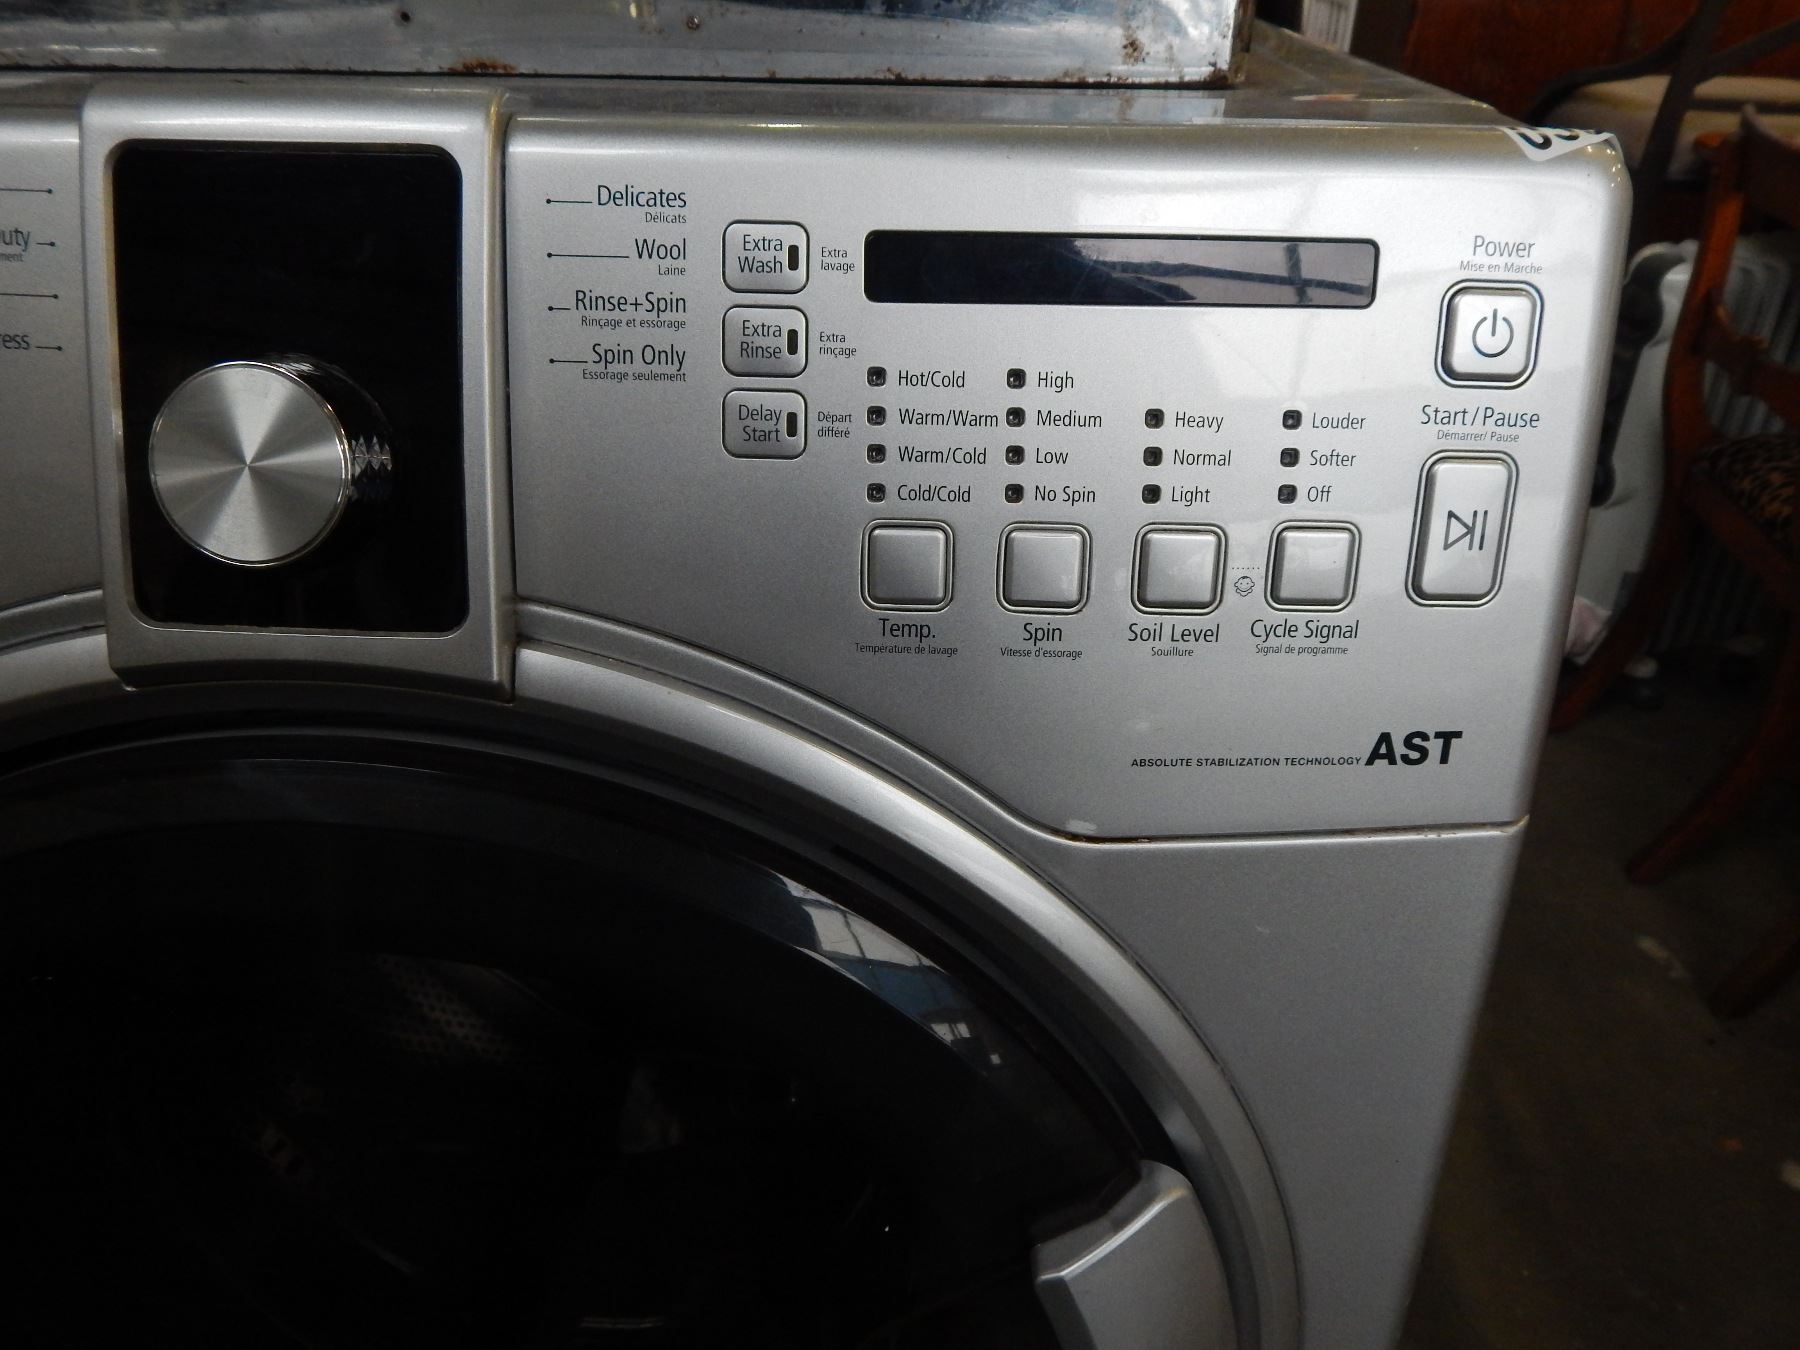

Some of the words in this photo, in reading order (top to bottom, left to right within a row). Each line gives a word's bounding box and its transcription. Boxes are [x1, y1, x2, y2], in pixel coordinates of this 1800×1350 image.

[597, 185, 687, 208] Delicates
[645, 212, 687, 224] Délicats
[0, 227, 31, 252] uty
[743, 234, 783, 251] Extra
[1473, 235, 1535, 257] Power
[635, 238, 687, 260] Wool
[821, 247, 848, 258] Extra
[658, 264, 686, 276] Laine
[738, 256, 783, 273] Wash
[820, 260, 855, 274] lavage
[1459, 260, 1485, 272] Mise
[1488, 263, 1500, 272] en
[1503, 262, 1543, 273] Marche
[575, 290, 687, 317] Rinse+Spin
[581, 315, 625, 330] Rinçage
[626, 318, 638, 328] et
[639, 318, 686, 331] essorage
[742, 320, 782, 337] Extra
[819, 332, 846, 342] Extra
[592, 343, 634, 369] Spin
[641, 345, 686, 371] Only
[740, 341, 782, 359] Rinse
[819, 344, 857, 358] rinçage
[582, 369, 629, 382] Essorage
[632, 371, 687, 382] seulement
[898, 370, 966, 388] Hot/Cold
[1037, 371, 1074, 392] High
[738, 404, 782, 425] Delay
[817, 411, 852, 424] Départ
[899, 409, 999, 427] Warm/Warm
[1036, 409, 1102, 428] Medium
[1175, 411, 1224, 433] Heavy
[1312, 412, 1366, 430] Louder
[1420, 404, 1540, 428] Start/Pause
[742, 426, 781, 442] Start
[817, 428, 850, 438] différé
[898, 446, 987, 465] Warm/Cold
[1035, 447, 1069, 464] Low
[1173, 449, 1232, 467] Normal
[1309, 450, 1356, 467] Softer
[897, 484, 971, 503] Cold/Cold
[1034, 486, 1057, 502] No
[1062, 486, 1096, 506] Spin
[1171, 486, 1211, 507] Light
[1307, 485, 1332, 503] Off
[878, 618, 936, 643] Temp.
[1022, 622, 1063, 646] Spin
[1128, 622, 1163, 642] Soil
[1170, 623, 1220, 643] Level
[1250, 619, 1299, 643] Cycle
[1303, 619, 1360, 643] Signal
[855, 643, 912, 655] Température
[914, 643, 926, 655] de
[928, 643, 958, 657] lavage
[1000, 647, 1032, 658] Vitesse
[1034, 647, 1083, 660] d'essorage
[1151, 646, 1194, 657] Souillure
[1255, 643, 1282, 656] Signal
[1284, 644, 1296, 655] de
[1297, 645, 1349, 657] programme
[1365, 730, 1463, 766] AST
[1131, 758, 1192, 767] ABSOLUTE
[1196, 757, 1280, 766] STABILIZATION
[1284, 756, 1361, 766] TECHNOLOGY
